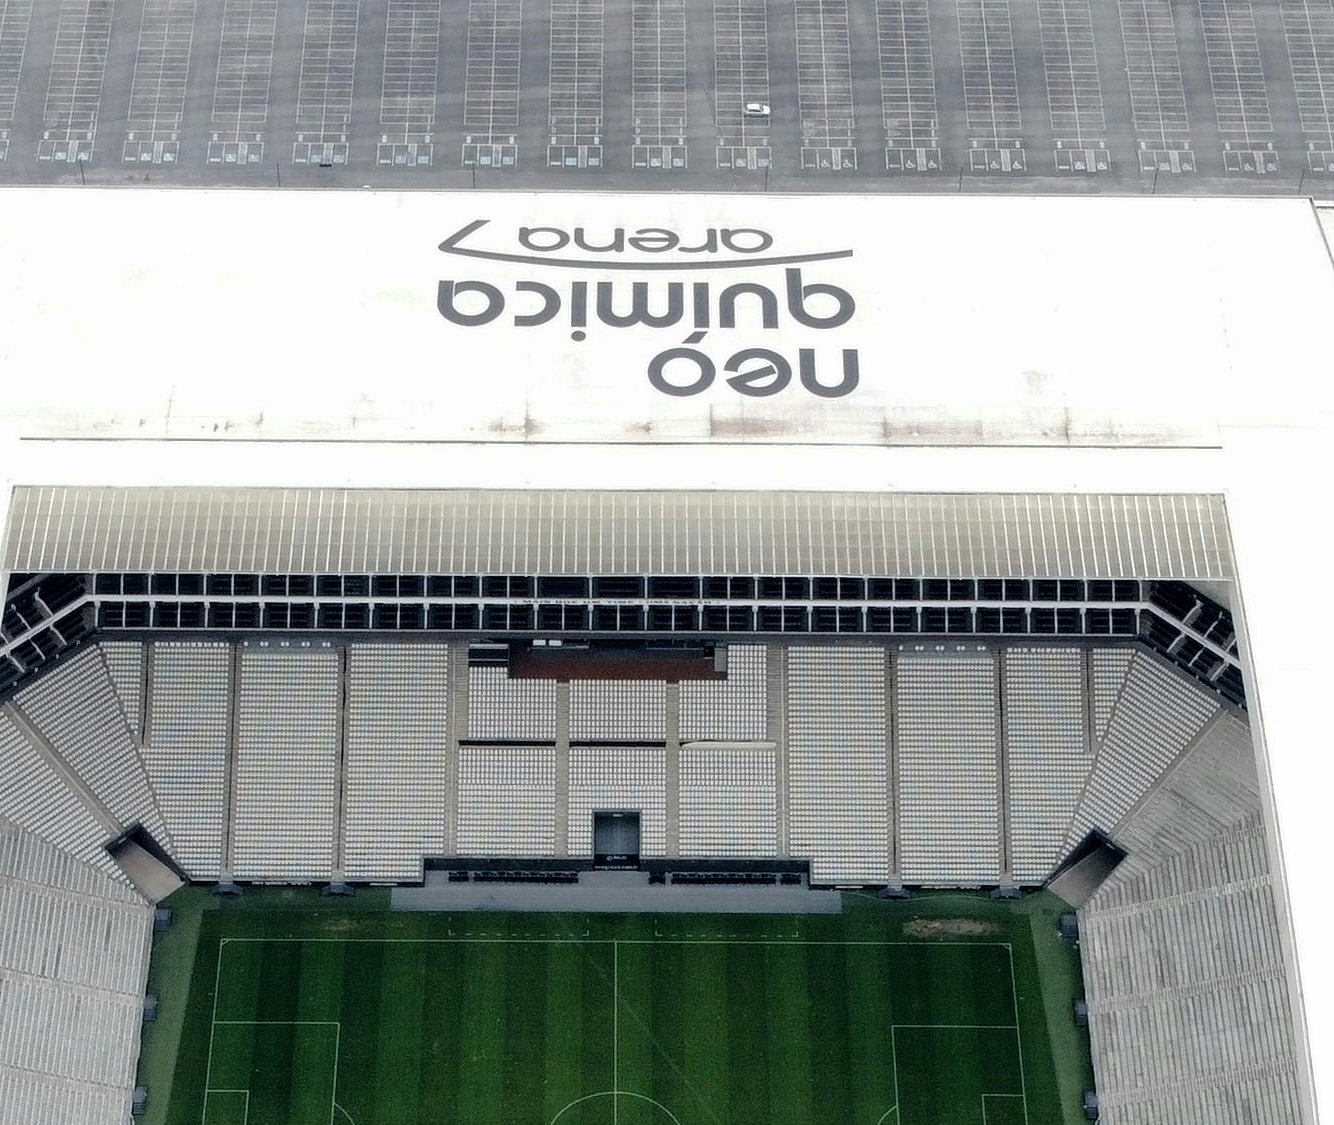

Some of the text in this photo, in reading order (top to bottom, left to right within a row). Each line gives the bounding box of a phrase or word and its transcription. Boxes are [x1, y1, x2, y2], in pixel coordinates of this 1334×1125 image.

[518, 227, 774, 253] arena
[437, 268, 855, 343] química
[648, 348, 859, 398] neo
